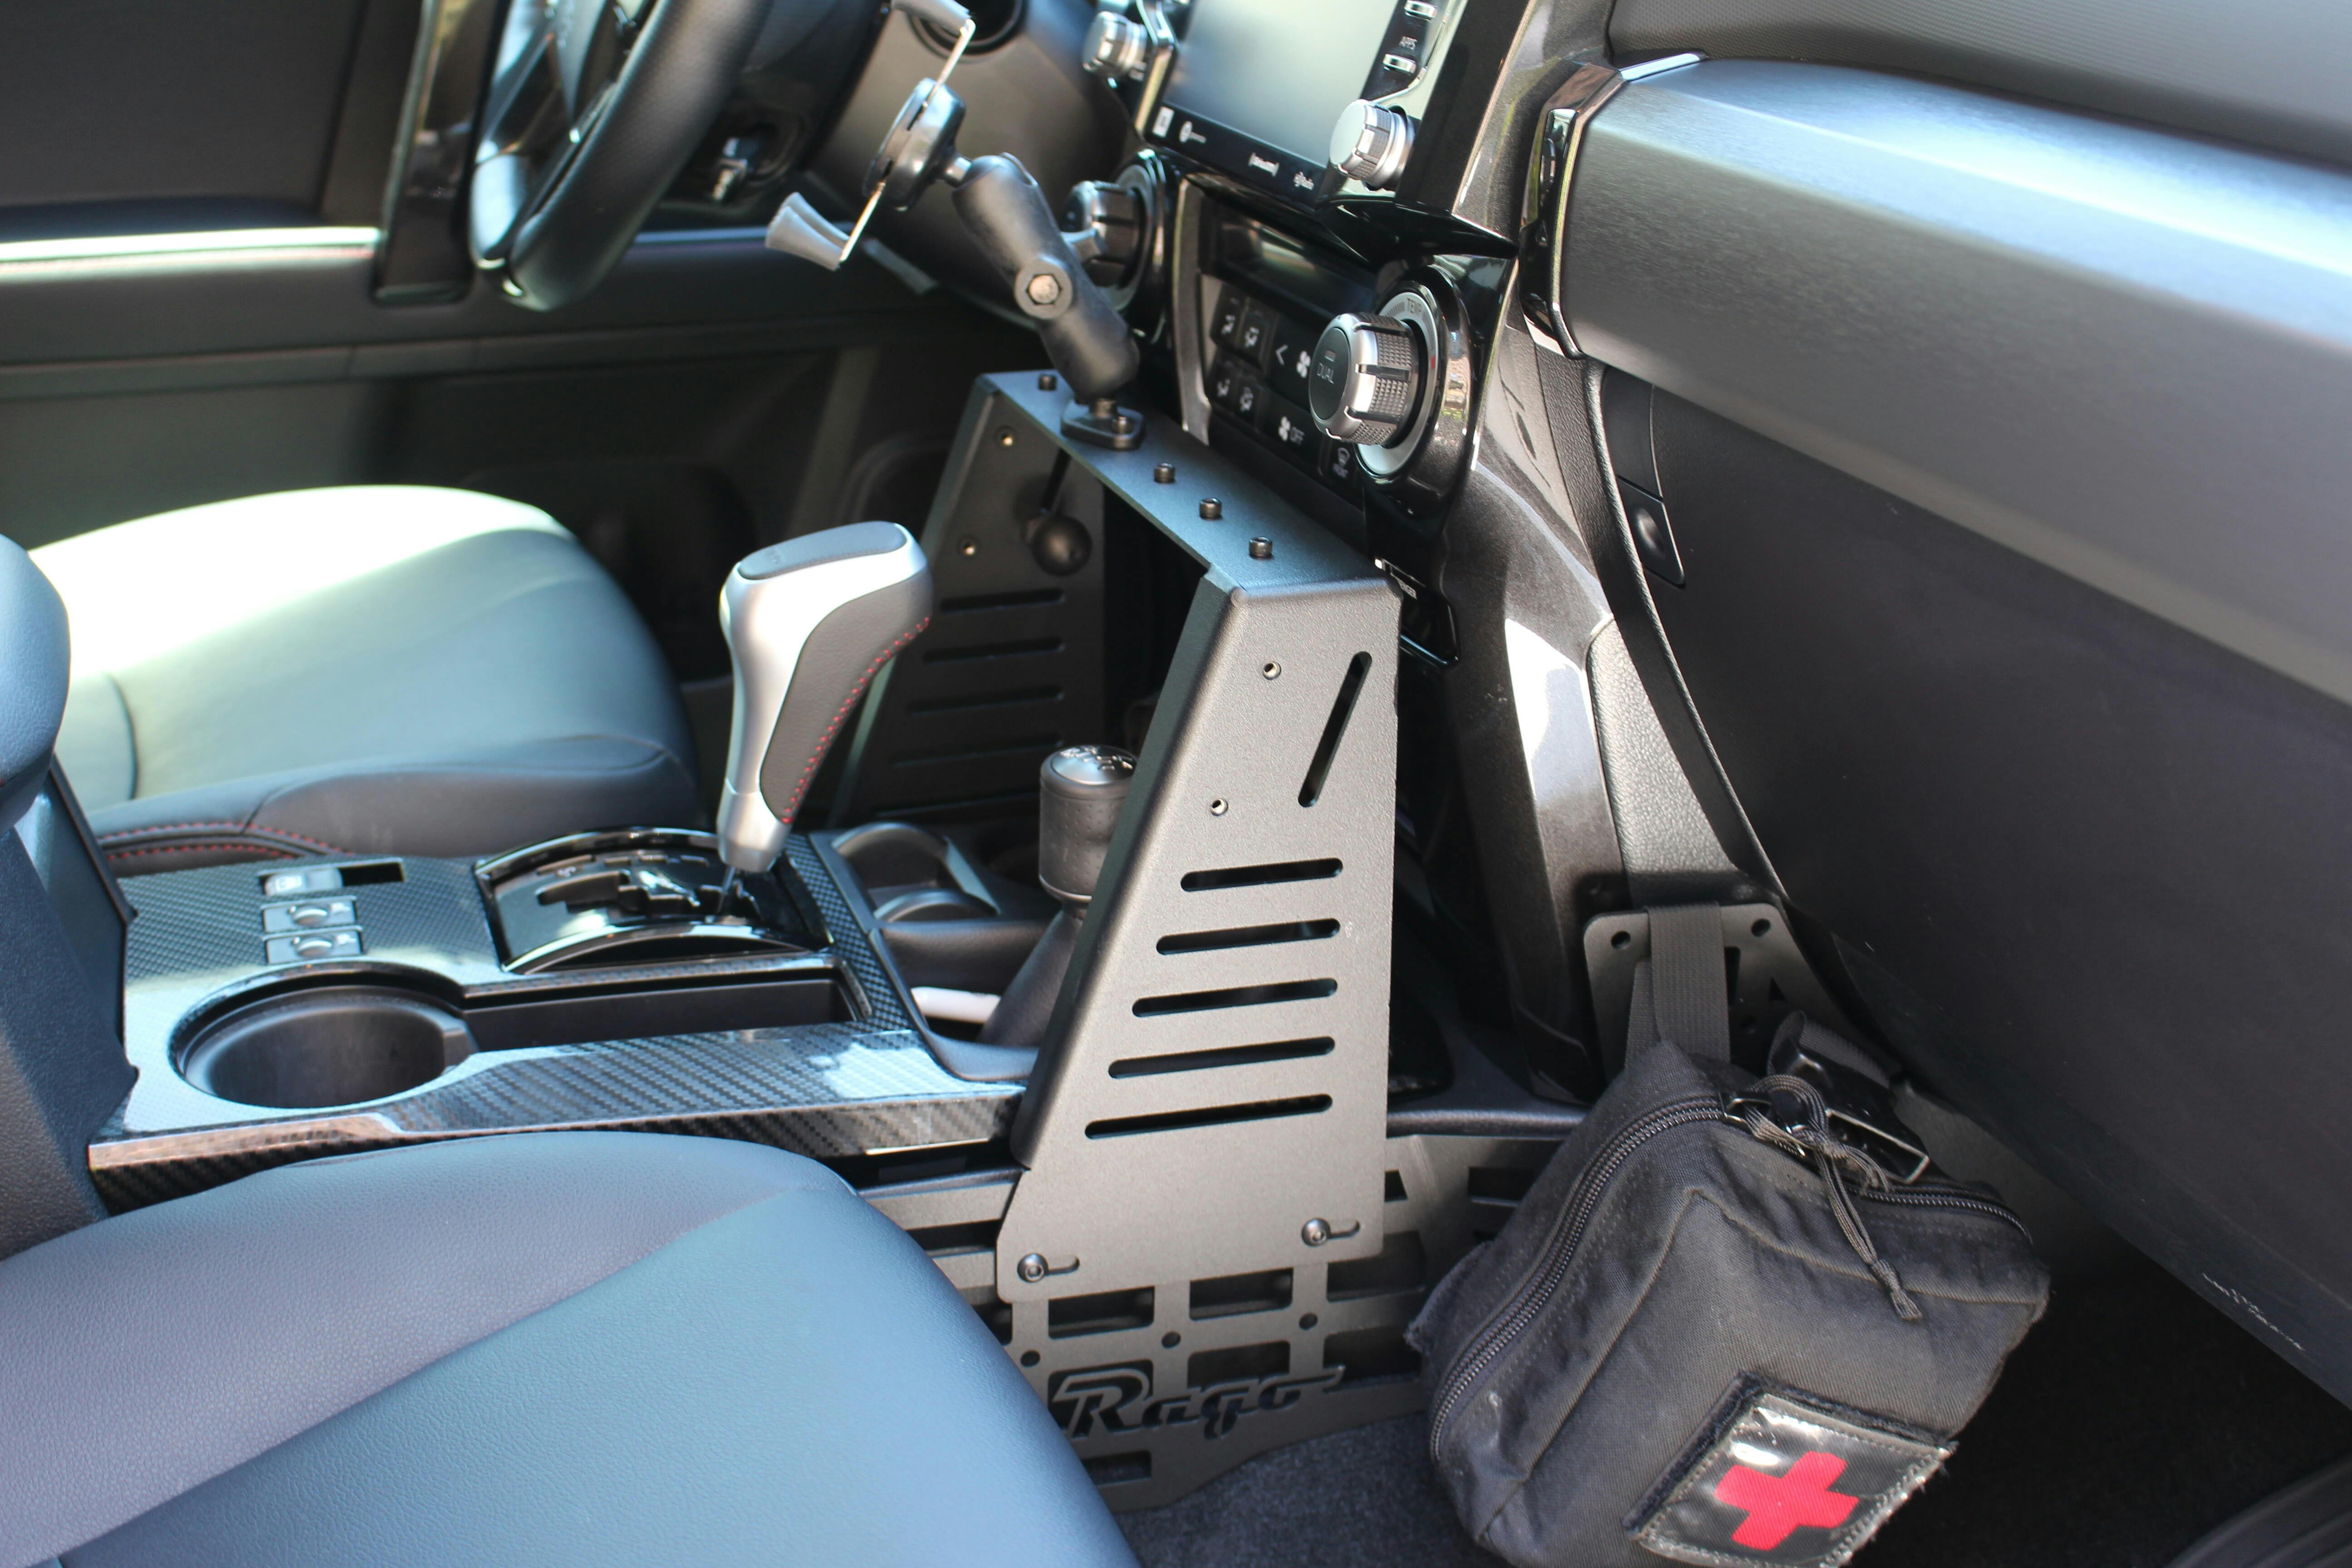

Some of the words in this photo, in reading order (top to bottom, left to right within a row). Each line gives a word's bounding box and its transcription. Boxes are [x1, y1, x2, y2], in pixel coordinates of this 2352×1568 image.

[1317, 363, 1334, 384] DUAL
[1290, 426, 1305, 445] OFF
[1052, 1367, 1346, 1440] Rago
